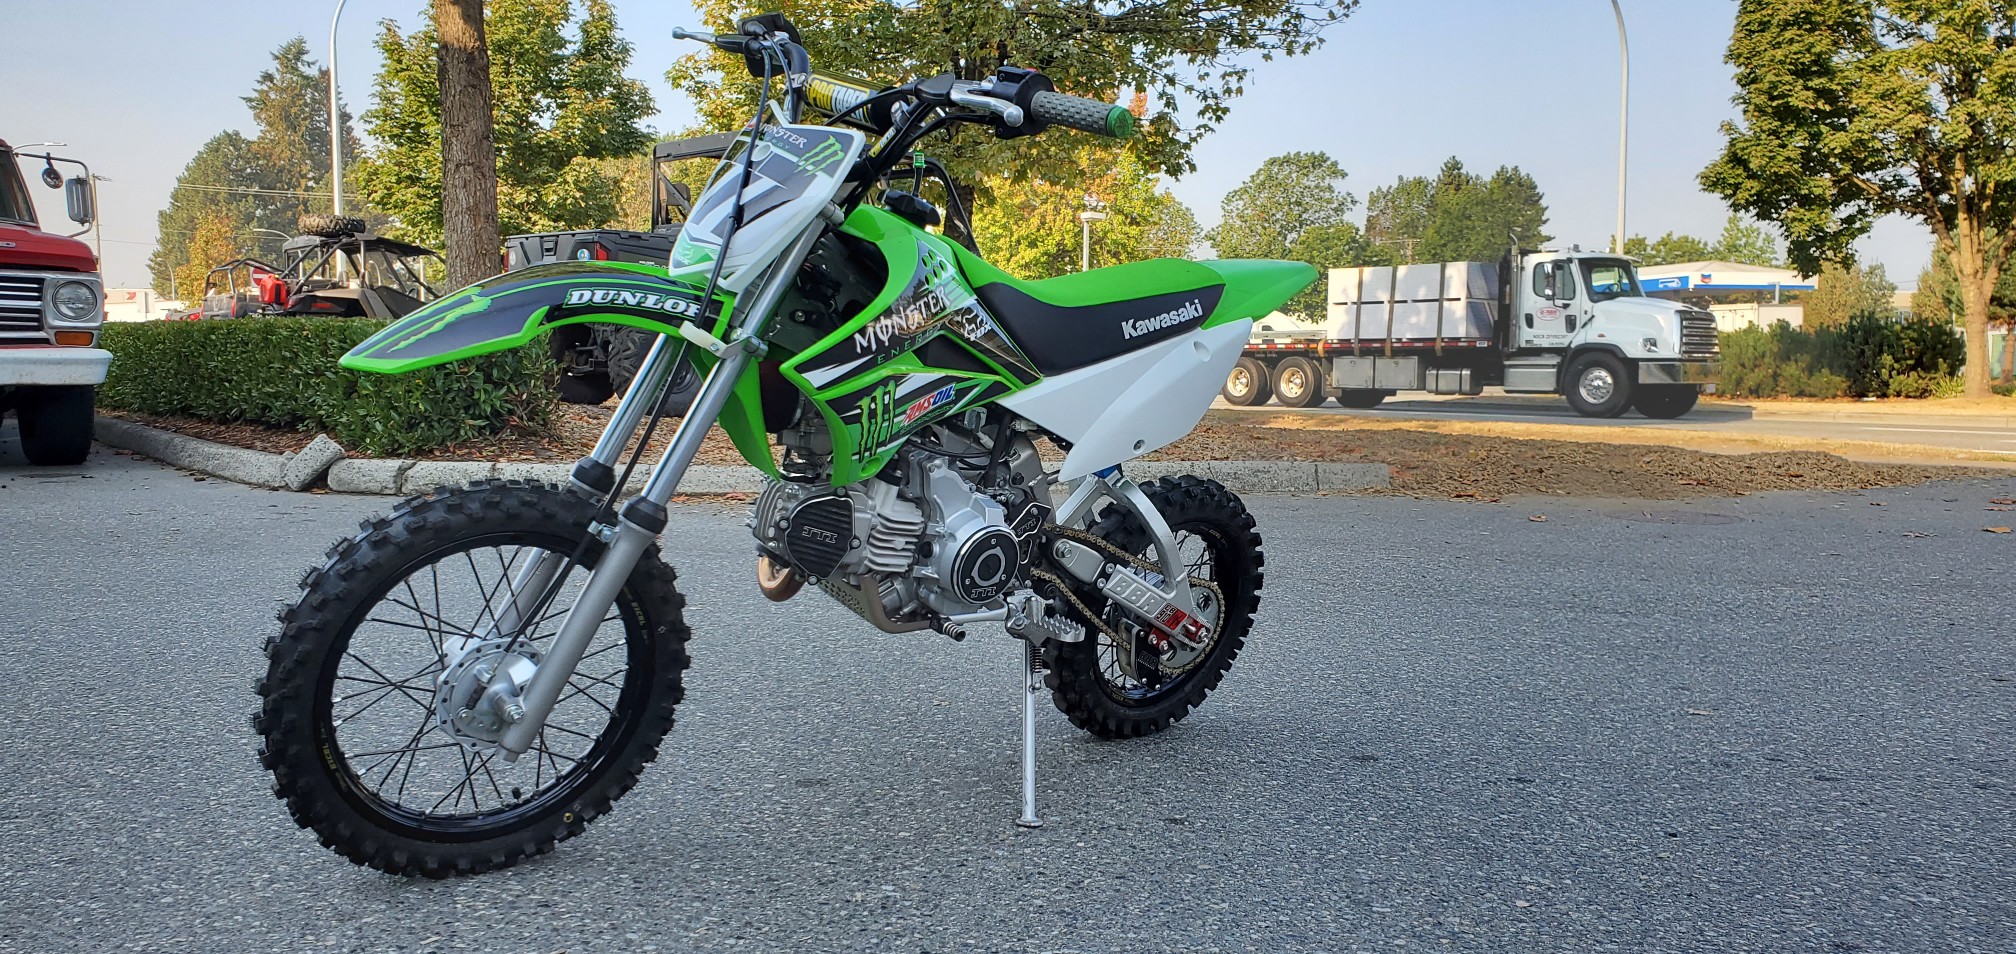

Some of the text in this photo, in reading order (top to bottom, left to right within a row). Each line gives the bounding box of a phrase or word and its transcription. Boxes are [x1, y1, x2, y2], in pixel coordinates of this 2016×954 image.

[853, 286, 951, 355] MONSTER
[969, 322, 992, 342] FOX
[1121, 298, 1204, 340] Kawasaki
[877, 322, 943, 365] ENERGY
[902, 384, 956, 426] AMSOIL
[1106, 573, 1165, 617] BBR
